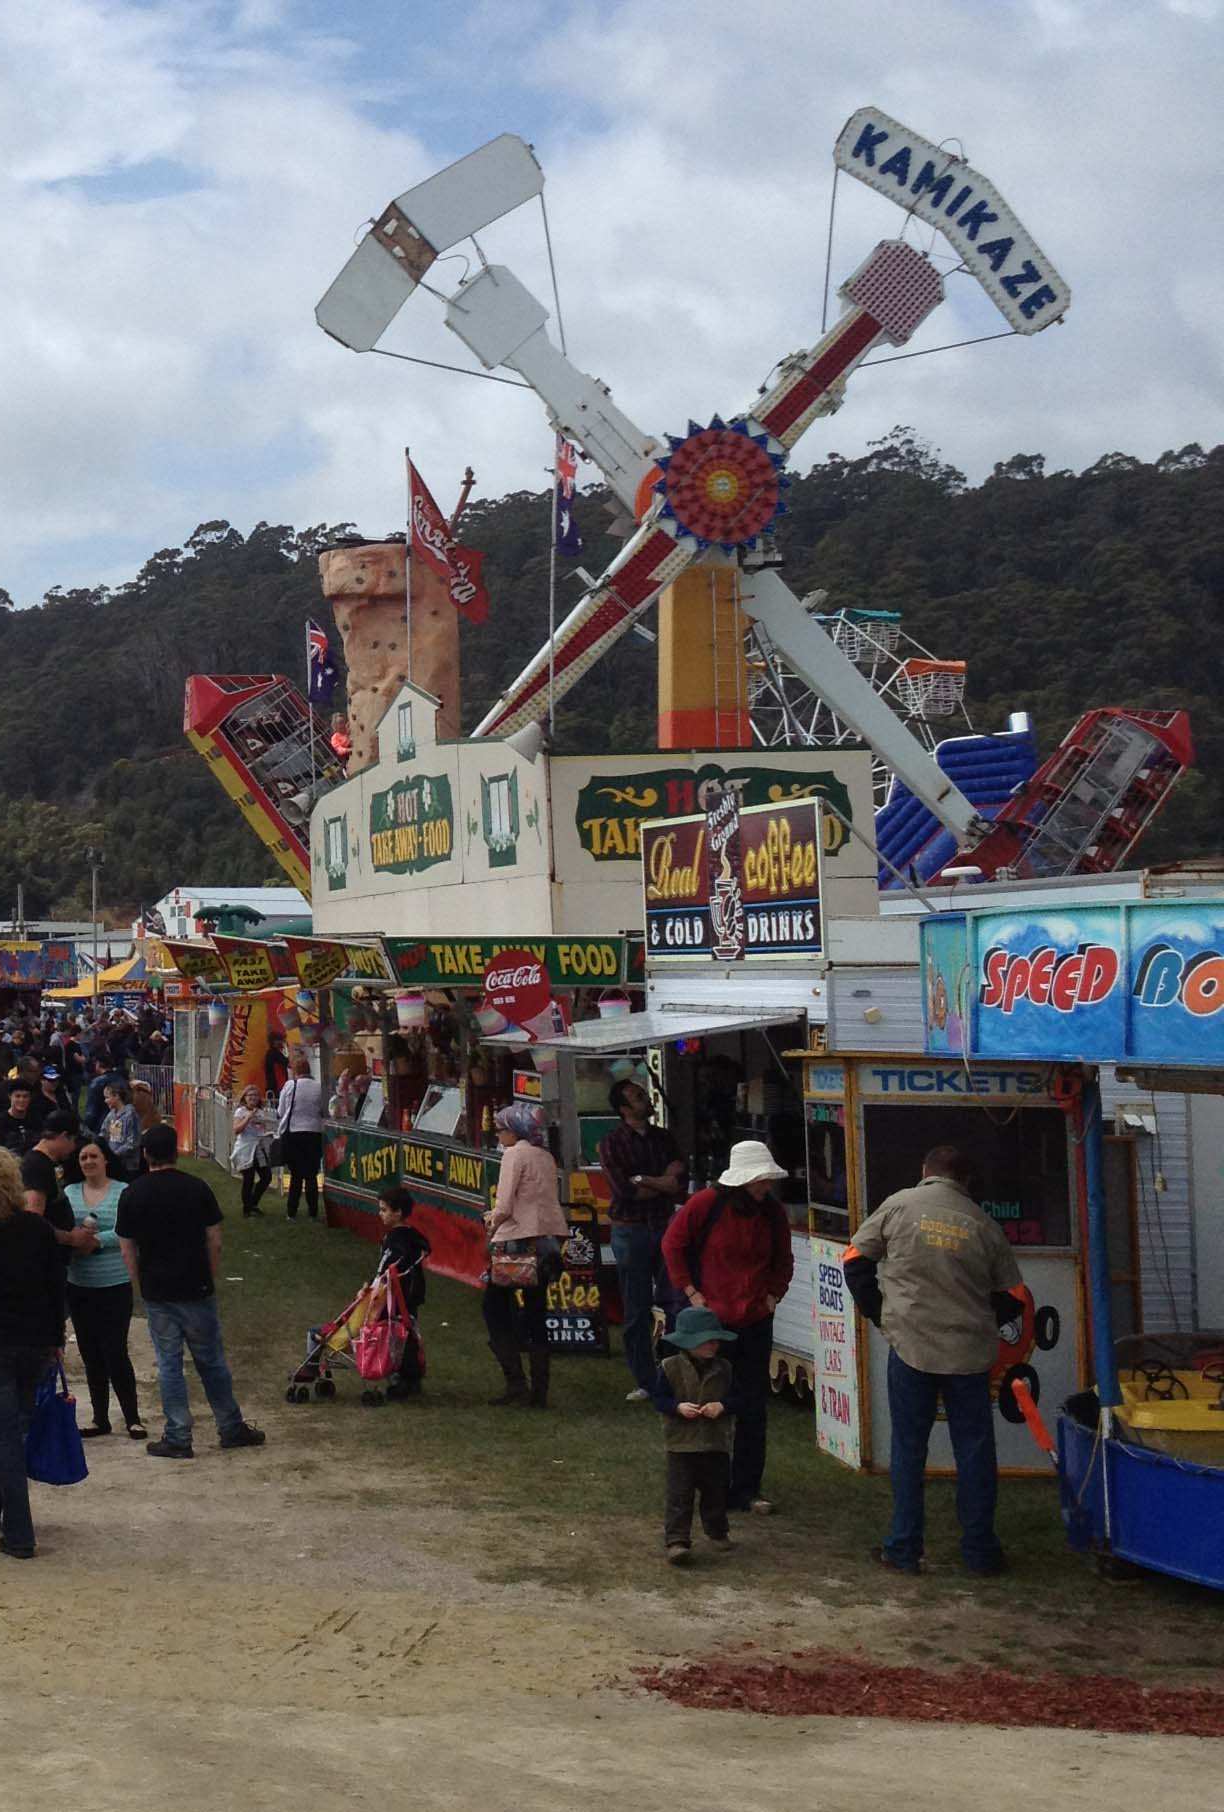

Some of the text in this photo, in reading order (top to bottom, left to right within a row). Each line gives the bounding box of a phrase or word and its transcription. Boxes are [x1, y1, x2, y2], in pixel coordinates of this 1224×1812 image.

[851, 122, 1057, 320] KAMIKAZE
[397, 788, 419, 823] HOT
[665, 777, 751, 814] HOT
[646, 828, 705, 899] Real
[743, 816, 817, 895] coffee
[651, 909, 815, 945] & COLD DRINKS
[557, 944, 618, 976] FOOD
[979, 942, 1120, 1015] SPEED
[872, 1069, 1042, 1094] TICKETS
[361, 1144, 397, 1184] TASTY
[403, 1144, 433, 1176] TAKE
[449, 1154, 482, 1189] AWAY
[981, 1200, 1021, 1218] Child
[545, 1271, 601, 1311] ffee
[818, 1262, 843, 1289] SPEED
[819, 1287, 844, 1313] BOATS
[545, 1317, 592, 1330] OLD
[548, 1329, 596, 1342] INKS
[819, 1320, 846, 1344] VINTAGE
[824, 1348, 842, 1373] CARS
[821, 1384, 851, 1426] & TRAIN
